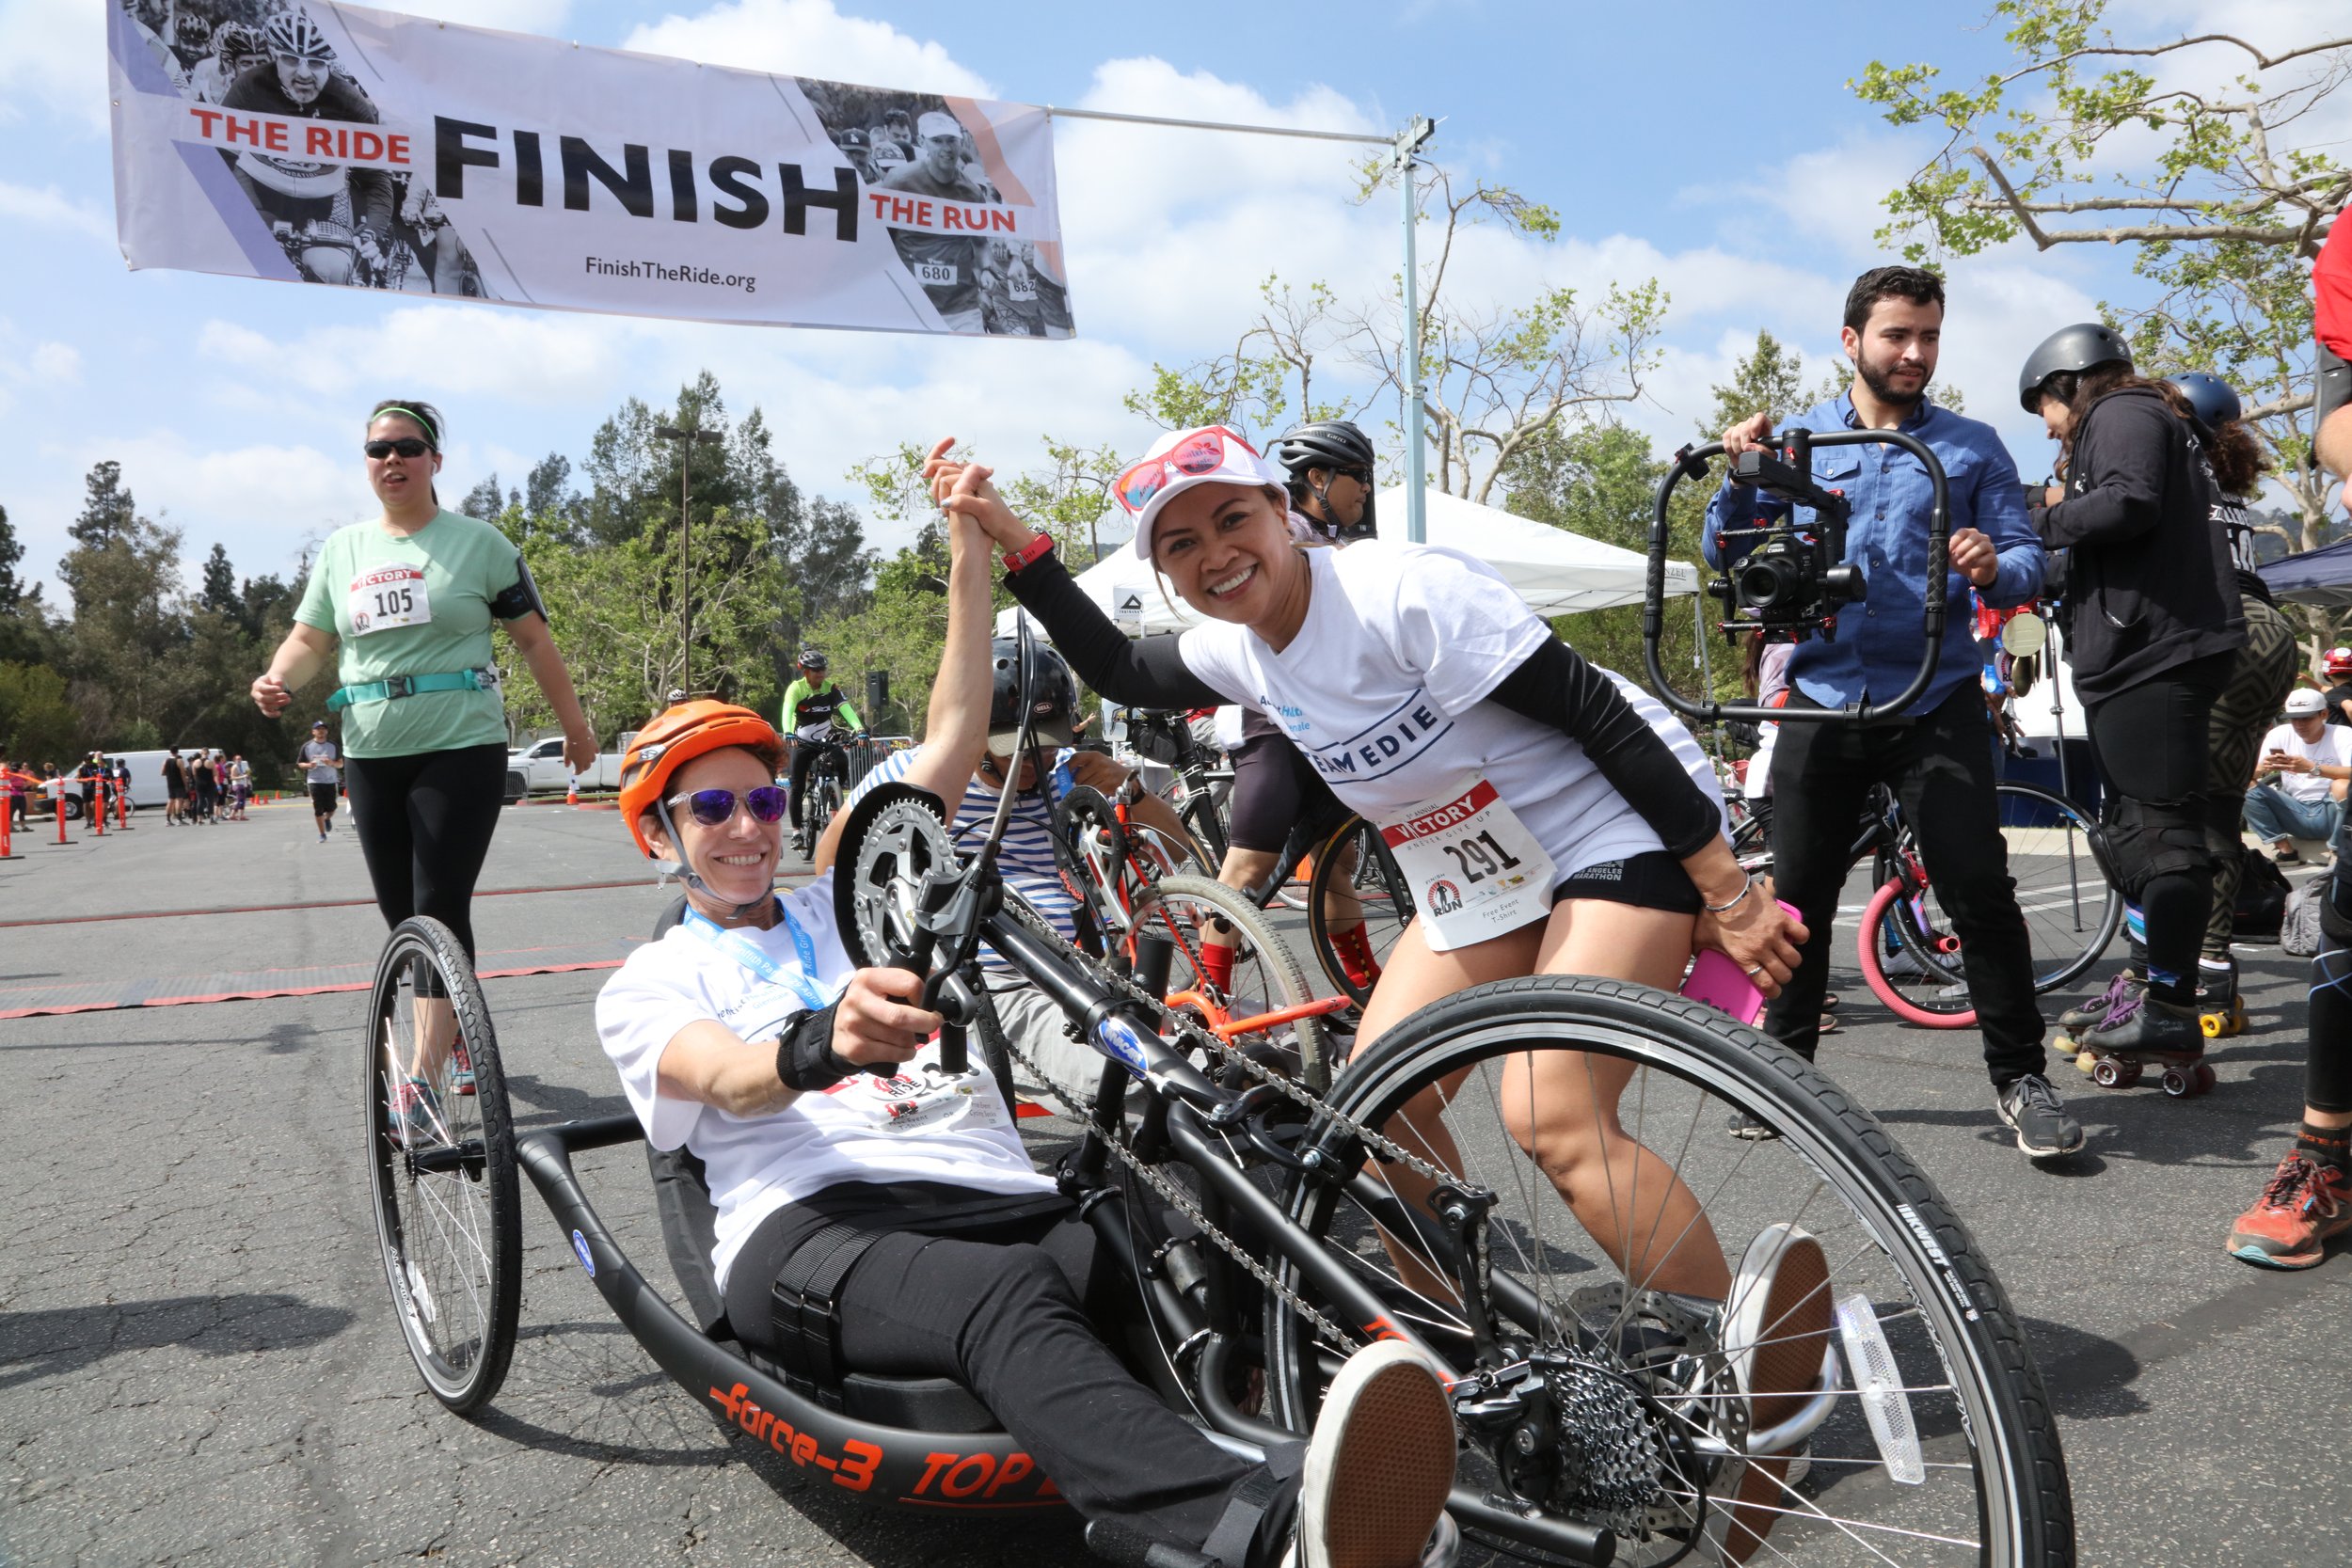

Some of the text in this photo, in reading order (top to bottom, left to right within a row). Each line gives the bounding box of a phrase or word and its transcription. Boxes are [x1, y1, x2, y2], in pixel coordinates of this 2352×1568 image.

[190, 108, 410, 165] THE RIDE
[434, 115, 859, 243] FINISH
[869, 194, 1016, 232] THE RUN
[585, 257, 756, 293] FinishTheRide.org
[922, 266, 950, 280] 680
[374, 588, 413, 617] 105
[1359, 705, 1438, 768] EDIE
[1414, 802, 1439, 816] ANNUAL
[1446, 824, 1470, 838] GIVE
[1476, 810, 1491, 823] UP
[1442, 830, 1521, 883] 291
[1572, 872, 1622, 881] MARATHON
[1433, 898, 1463, 917] RUN
[1482, 898, 1519, 919] Free Event
[1491, 910, 1518, 924] T-Shirt
[804, 949, 813, 971] Ride
[801, 986, 821, 1006] April
[1905, 1216, 1950, 1267] KWEST
[709, 1382, 883, 1492] force-3
[911, 1451, 1036, 1498] TOP
